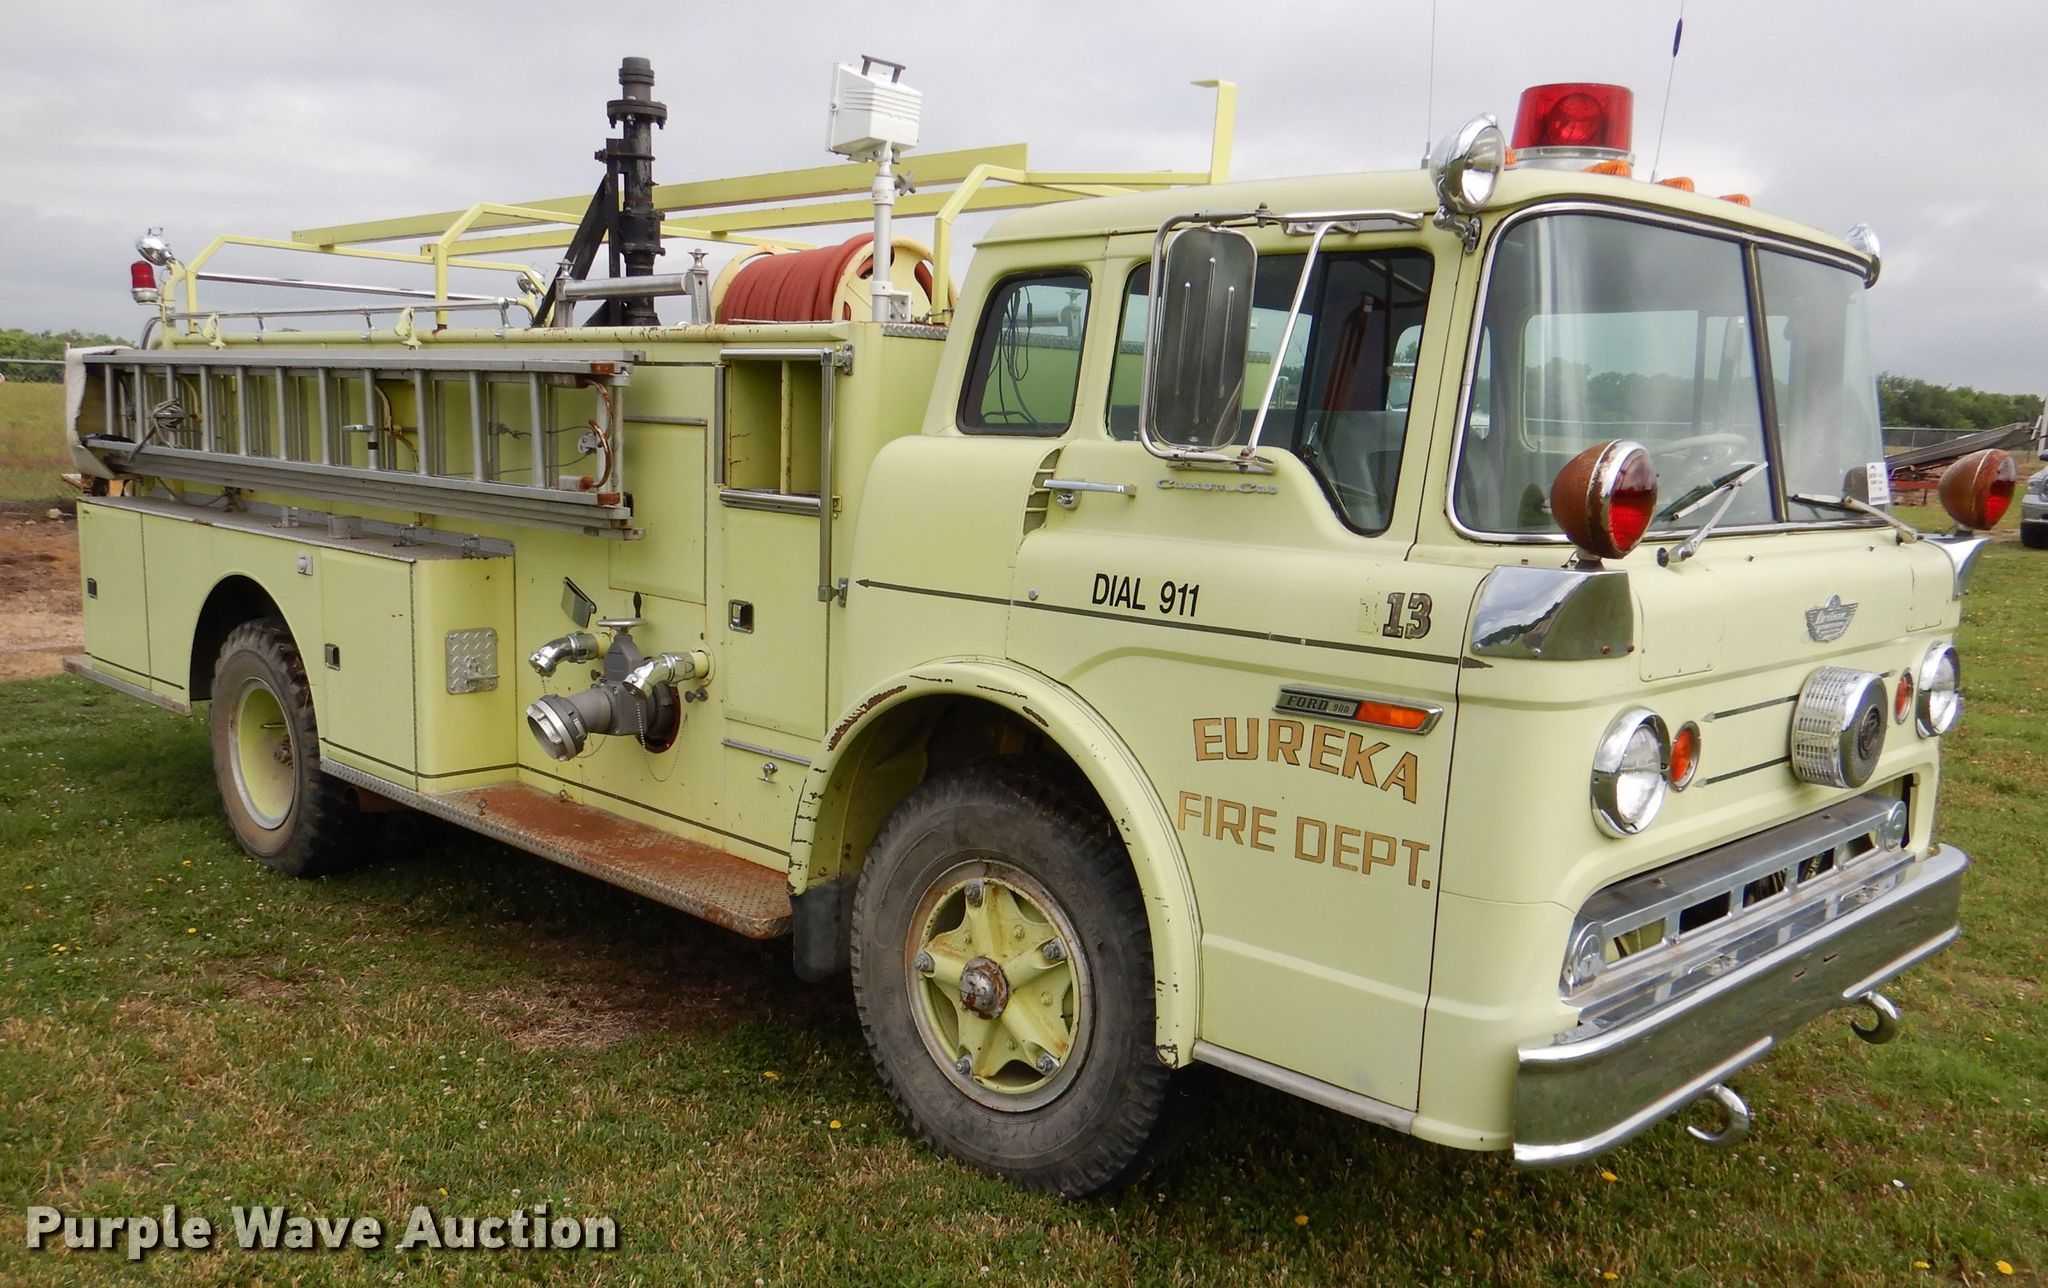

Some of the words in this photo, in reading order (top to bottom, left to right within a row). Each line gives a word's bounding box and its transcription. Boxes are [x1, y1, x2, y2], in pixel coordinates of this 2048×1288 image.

[1092, 573, 1146, 611] DIAL
[1159, 580, 1200, 617] 911
[1382, 592, 1432, 639] 13
[1286, 695, 1328, 711] FORD
[1332, 703, 1351, 713] 900
[1192, 717, 1419, 804] EUREKA
[1178, 791, 1278, 852] FIRE
[1294, 816, 1431, 889] DEPT.
